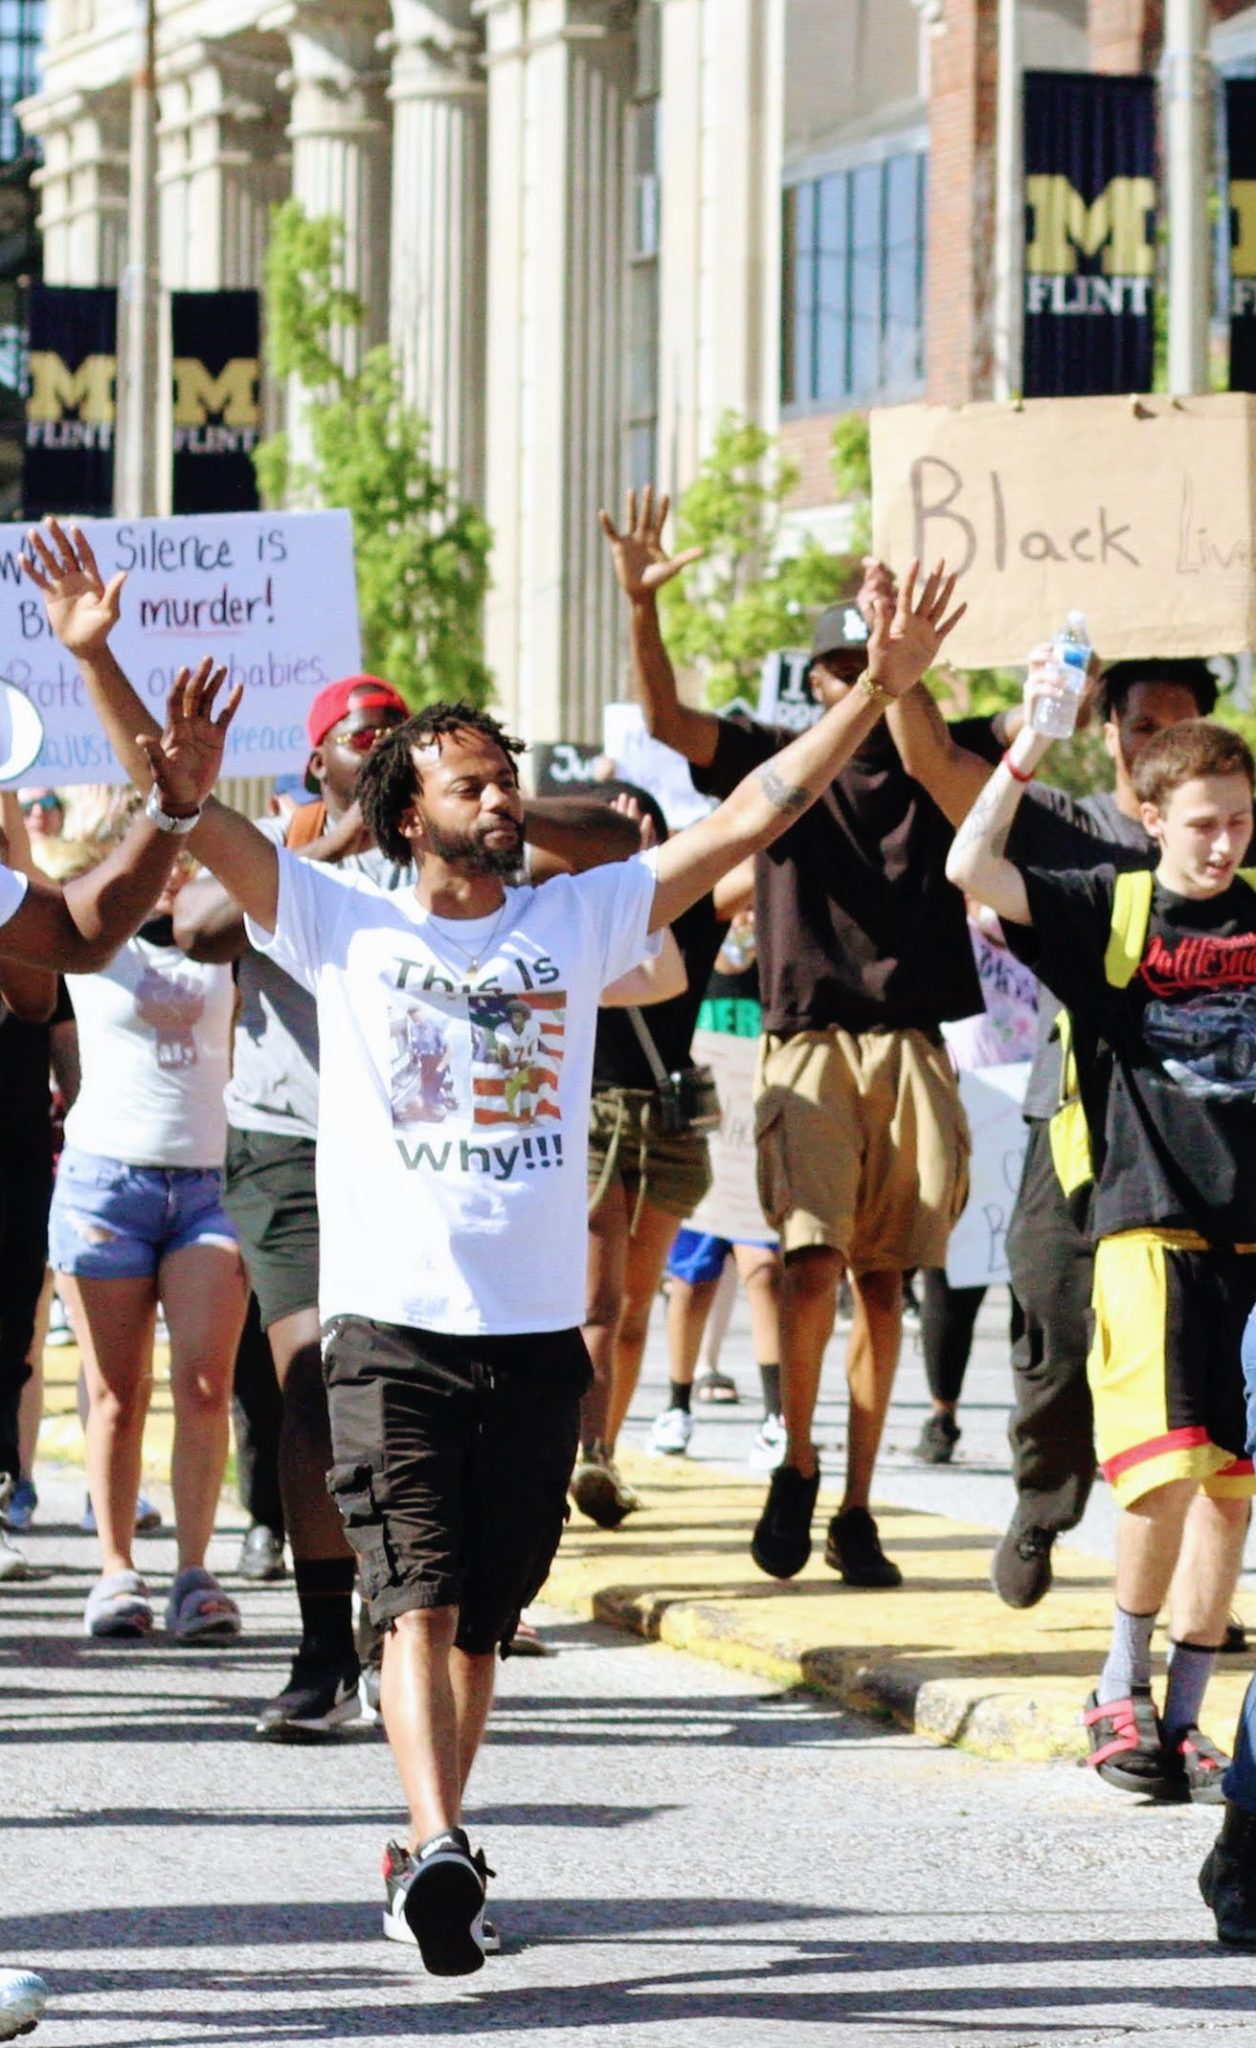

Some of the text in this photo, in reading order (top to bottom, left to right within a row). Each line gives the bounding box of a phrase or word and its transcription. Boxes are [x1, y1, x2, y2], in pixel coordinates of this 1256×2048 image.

[1026, 173, 1155, 275] M
[1026, 276, 1150, 316] FLINT
[26, 351, 117, 423] M
[173, 357, 261, 425] M
[910, 455, 1139, 588] Black
[115, 526, 234, 572] Silence
[140, 577, 275, 628] murder!
[514, 956, 560, 991] Is
[395, 1133, 563, 1181] Why!!!
